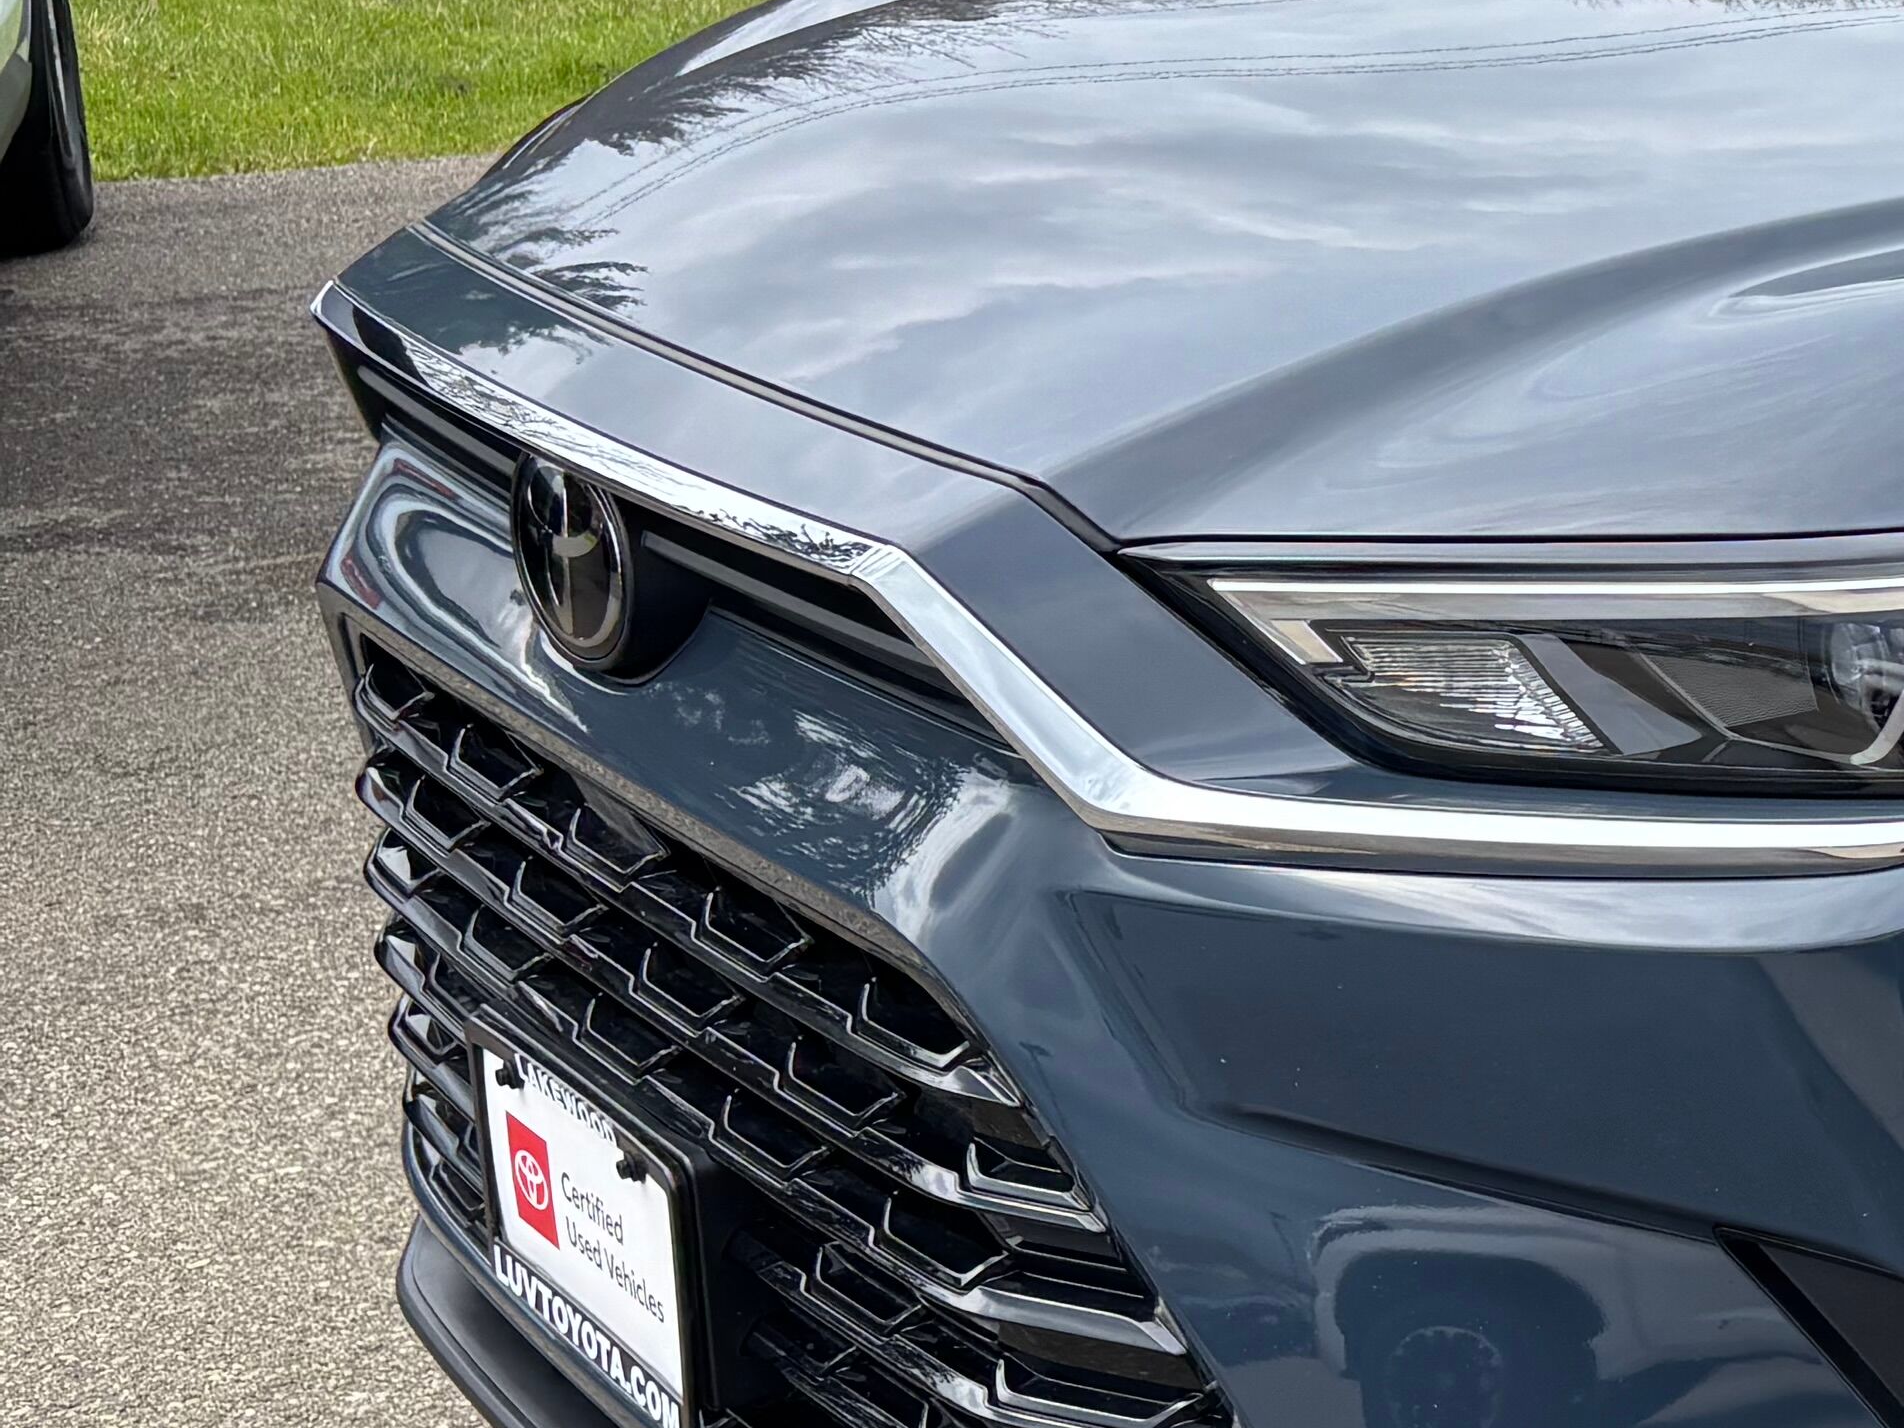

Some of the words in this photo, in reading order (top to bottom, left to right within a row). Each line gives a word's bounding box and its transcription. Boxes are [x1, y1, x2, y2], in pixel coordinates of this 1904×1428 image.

[514, 1053, 618, 1148] LAKEWOOD
[561, 1171, 624, 1246] Certified
[566, 1215, 602, 1271] Used
[604, 1247, 665, 1323] Vehicles
